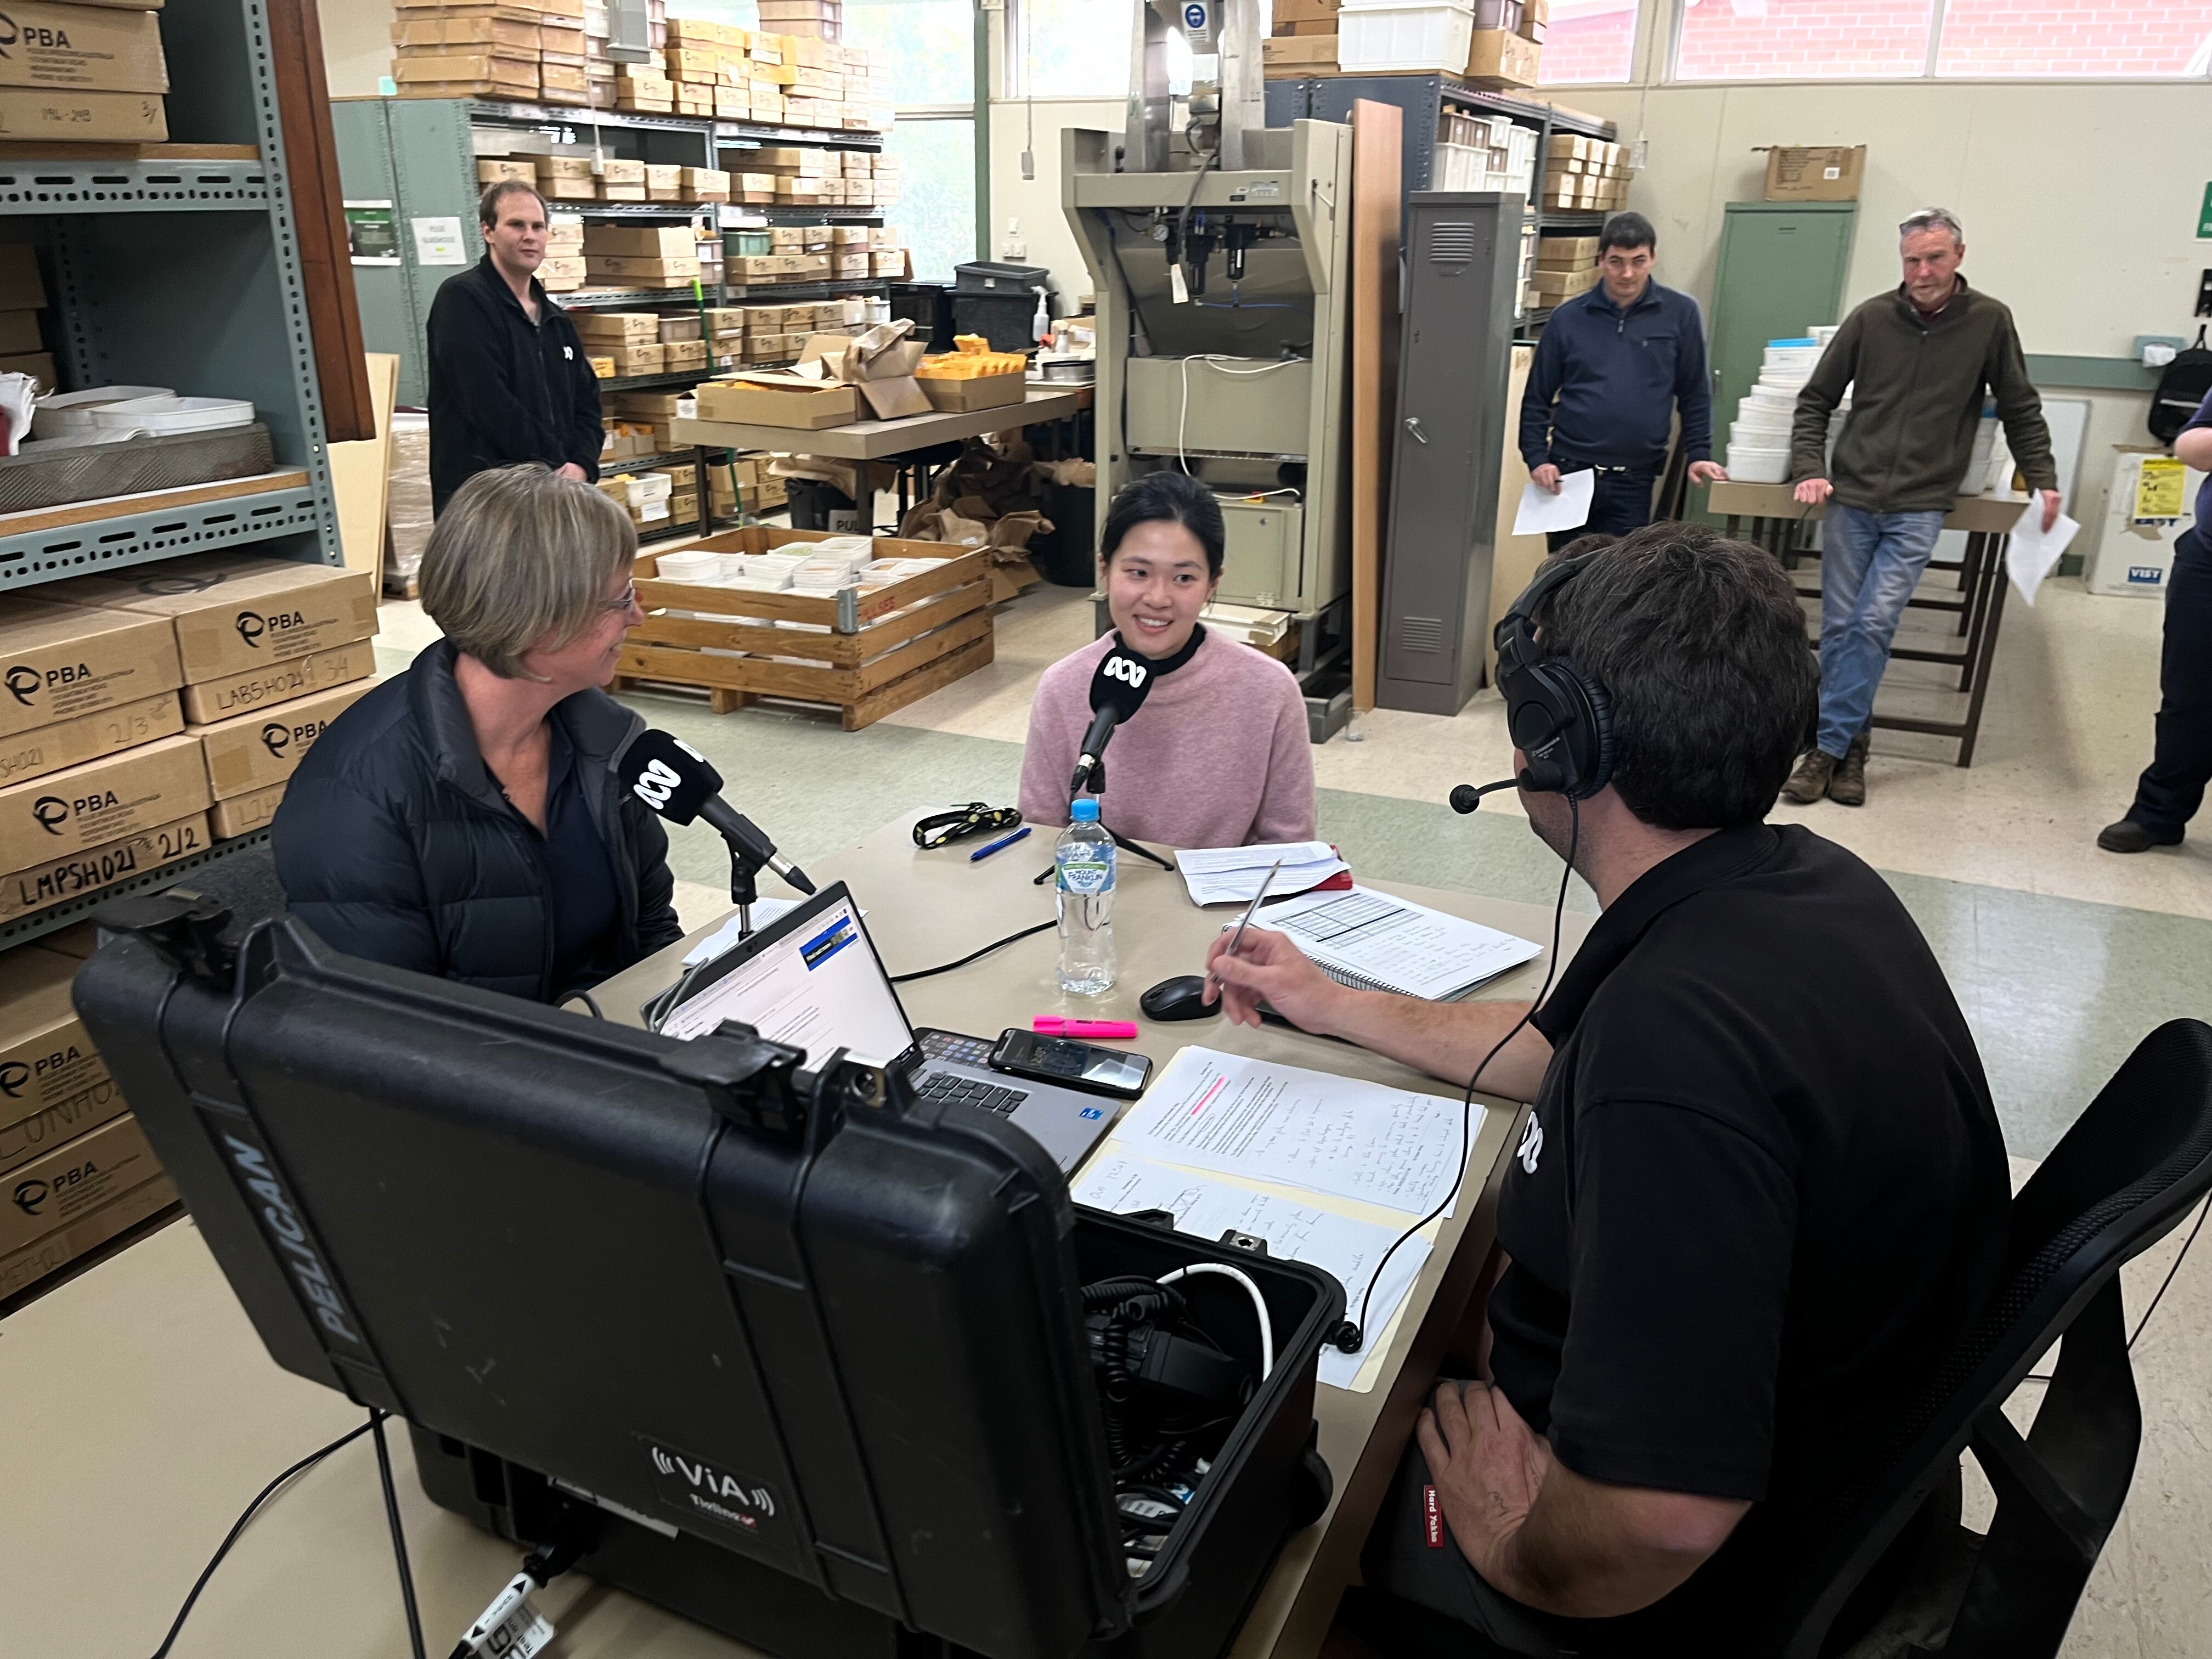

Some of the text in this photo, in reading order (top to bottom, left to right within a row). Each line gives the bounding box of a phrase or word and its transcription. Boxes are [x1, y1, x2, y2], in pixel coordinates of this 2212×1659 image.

[22, 26, 71, 49] PBA
[268, 611, 305, 631] PBA
[46, 663, 92, 687] PBA
[294, 720, 328, 741] PBA
[73, 791, 119, 816] PBA
[34, 1046, 81, 1076] PBA
[53, 1160, 99, 1192] PBA
[224, 1133, 359, 1344] PELICAN
[1428, 1490, 1437, 1512] Hard
